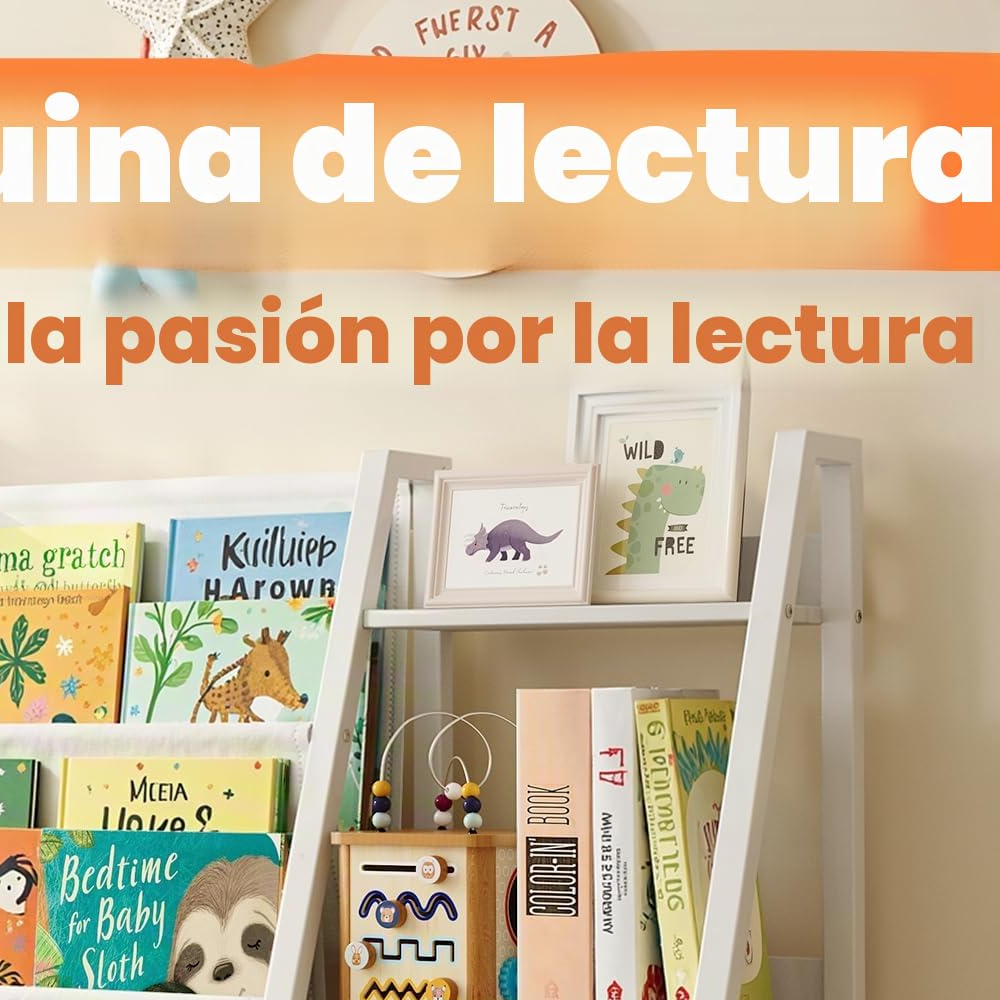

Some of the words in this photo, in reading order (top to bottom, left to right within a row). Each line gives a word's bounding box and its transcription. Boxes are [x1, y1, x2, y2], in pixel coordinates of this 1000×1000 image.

[533, 19, 559, 49] A
[623, 439, 665, 461] WILD
[42, 538, 127, 578] gratch
[654, 535, 696, 557] FREE
[526, 784, 570, 826] BOOK
[60, 845, 180, 902] Bedtime
[68, 911, 91, 936] for
[96, 892, 166, 949] Baby
[80, 943, 146, 990] Sloth
